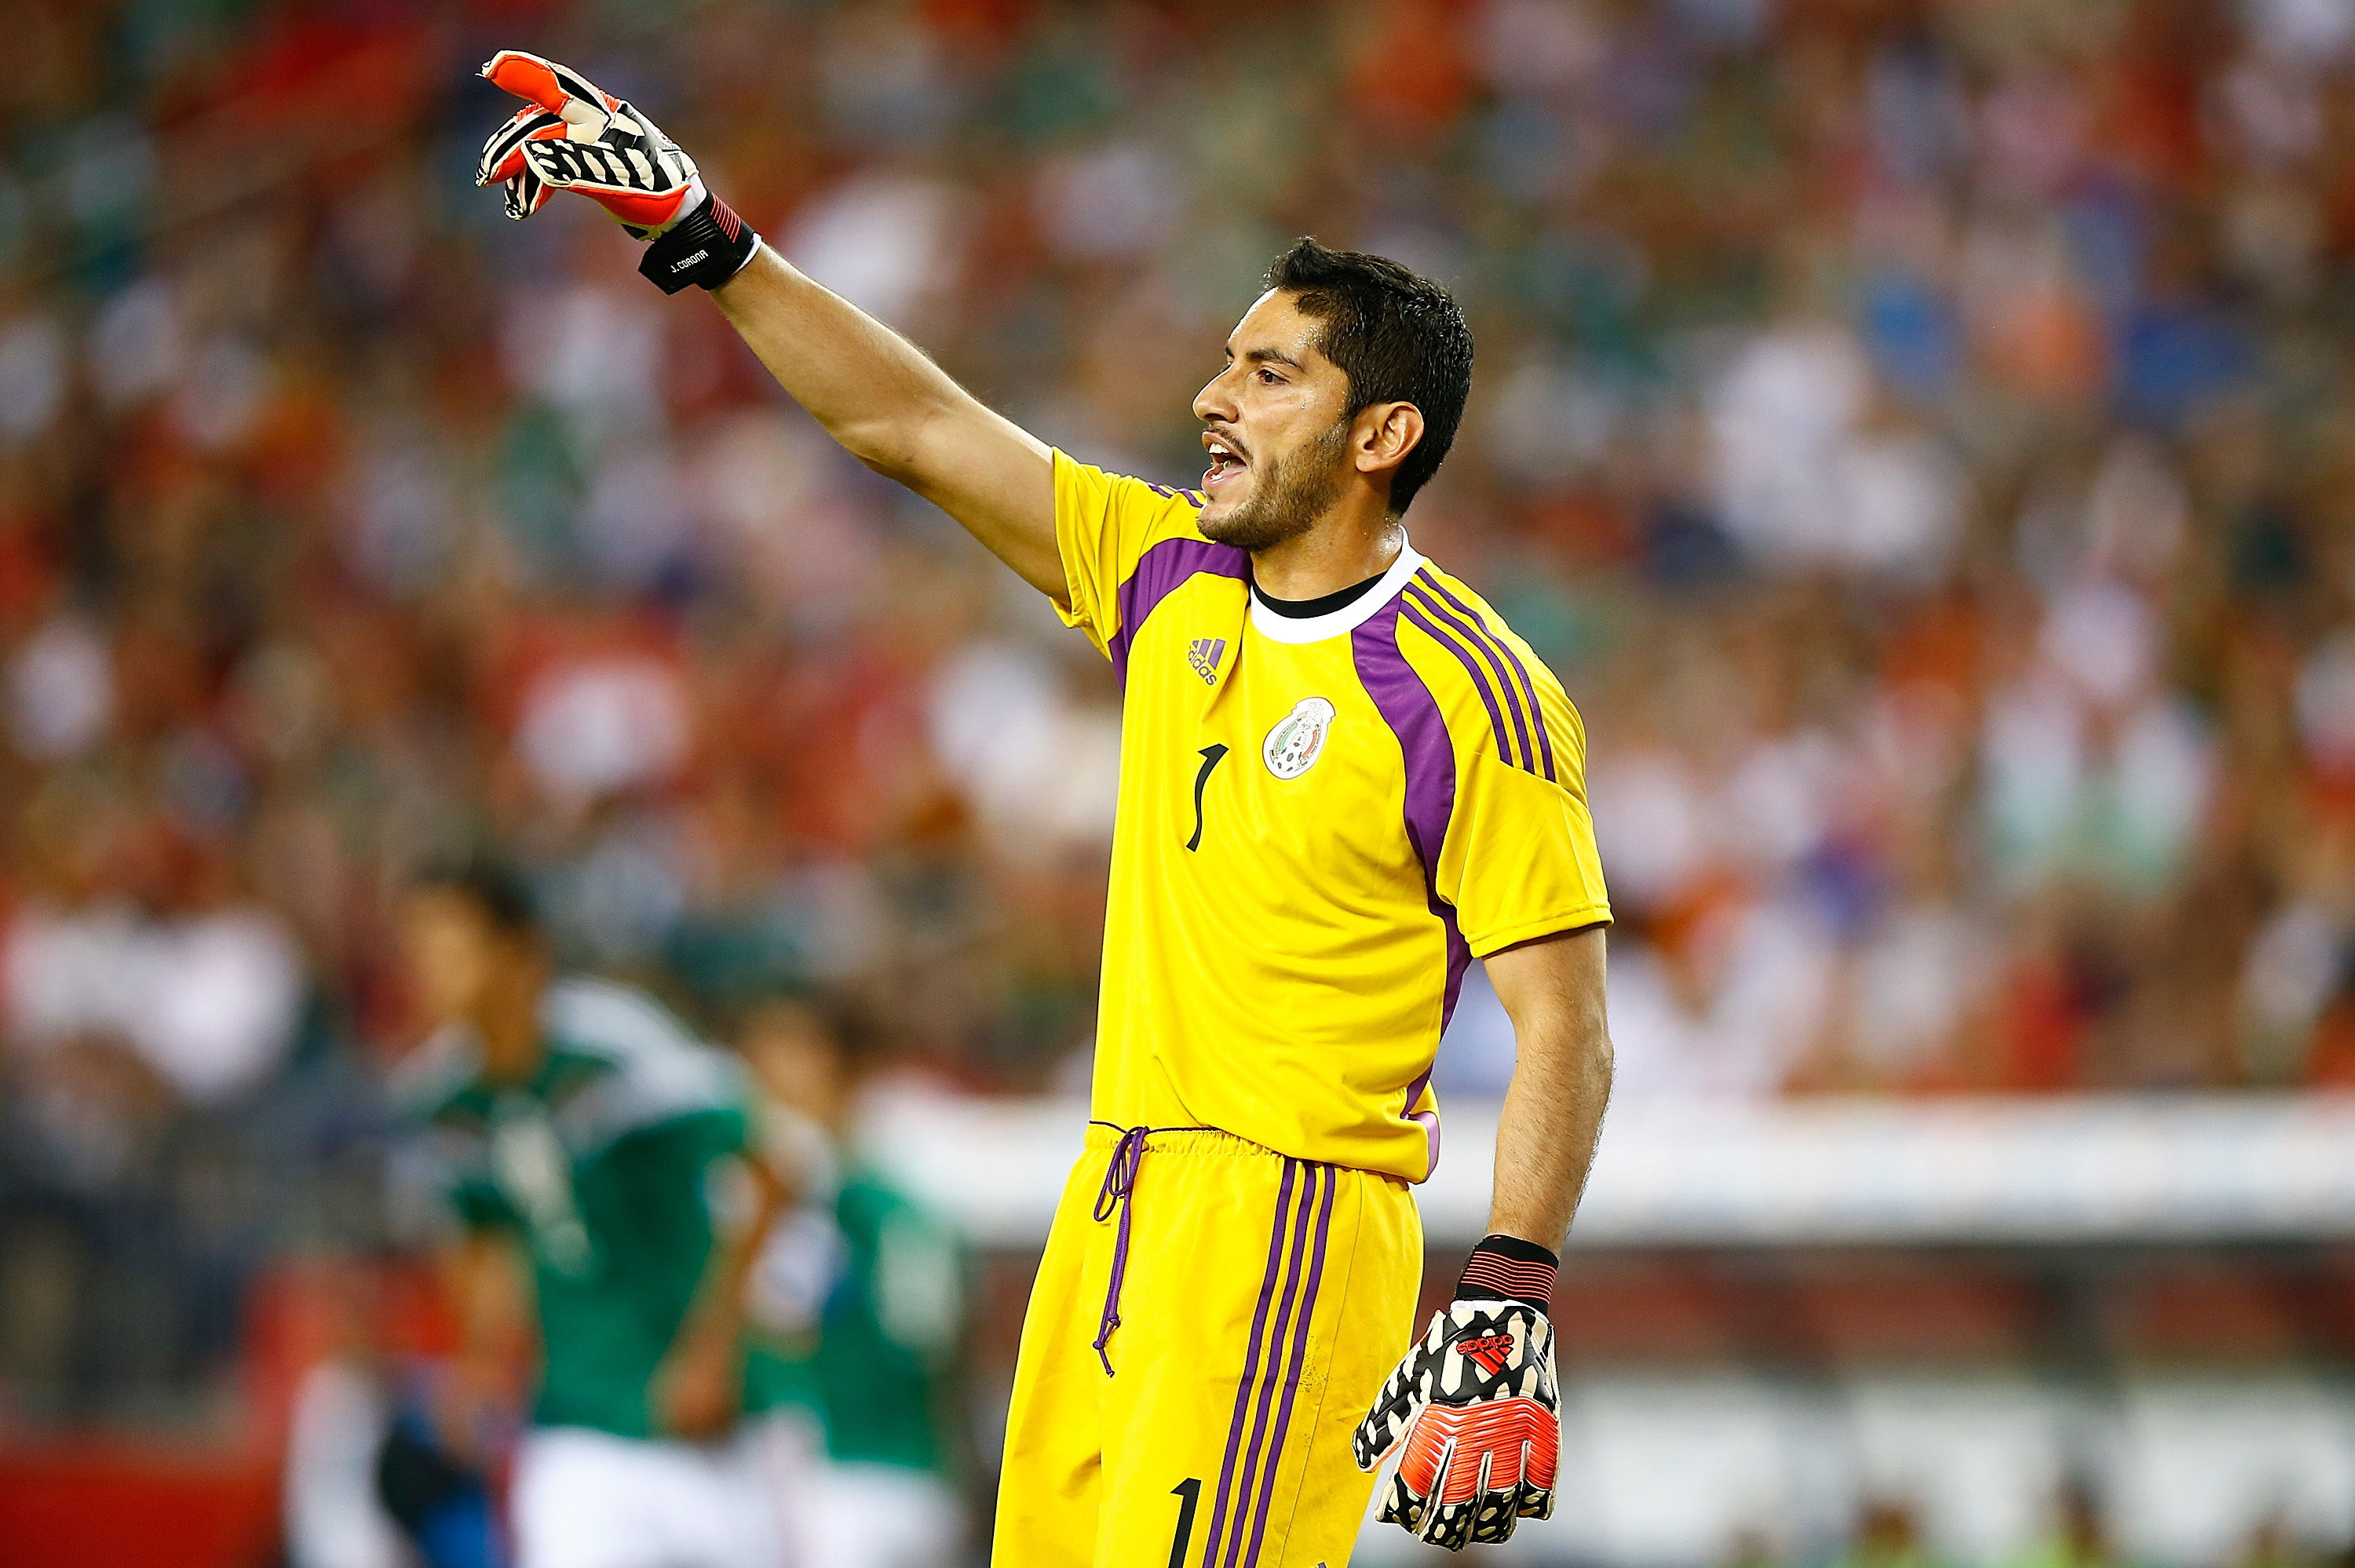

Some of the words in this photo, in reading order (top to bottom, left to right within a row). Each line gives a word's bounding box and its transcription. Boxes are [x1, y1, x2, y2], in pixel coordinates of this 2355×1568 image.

[677, 250, 709, 269] CORONA
[1188, 645, 1218, 686] didas
[1186, 743, 1229, 852] 1
[1456, 1334, 1514, 1355] adidas
[1167, 1477, 1202, 1568] 1
